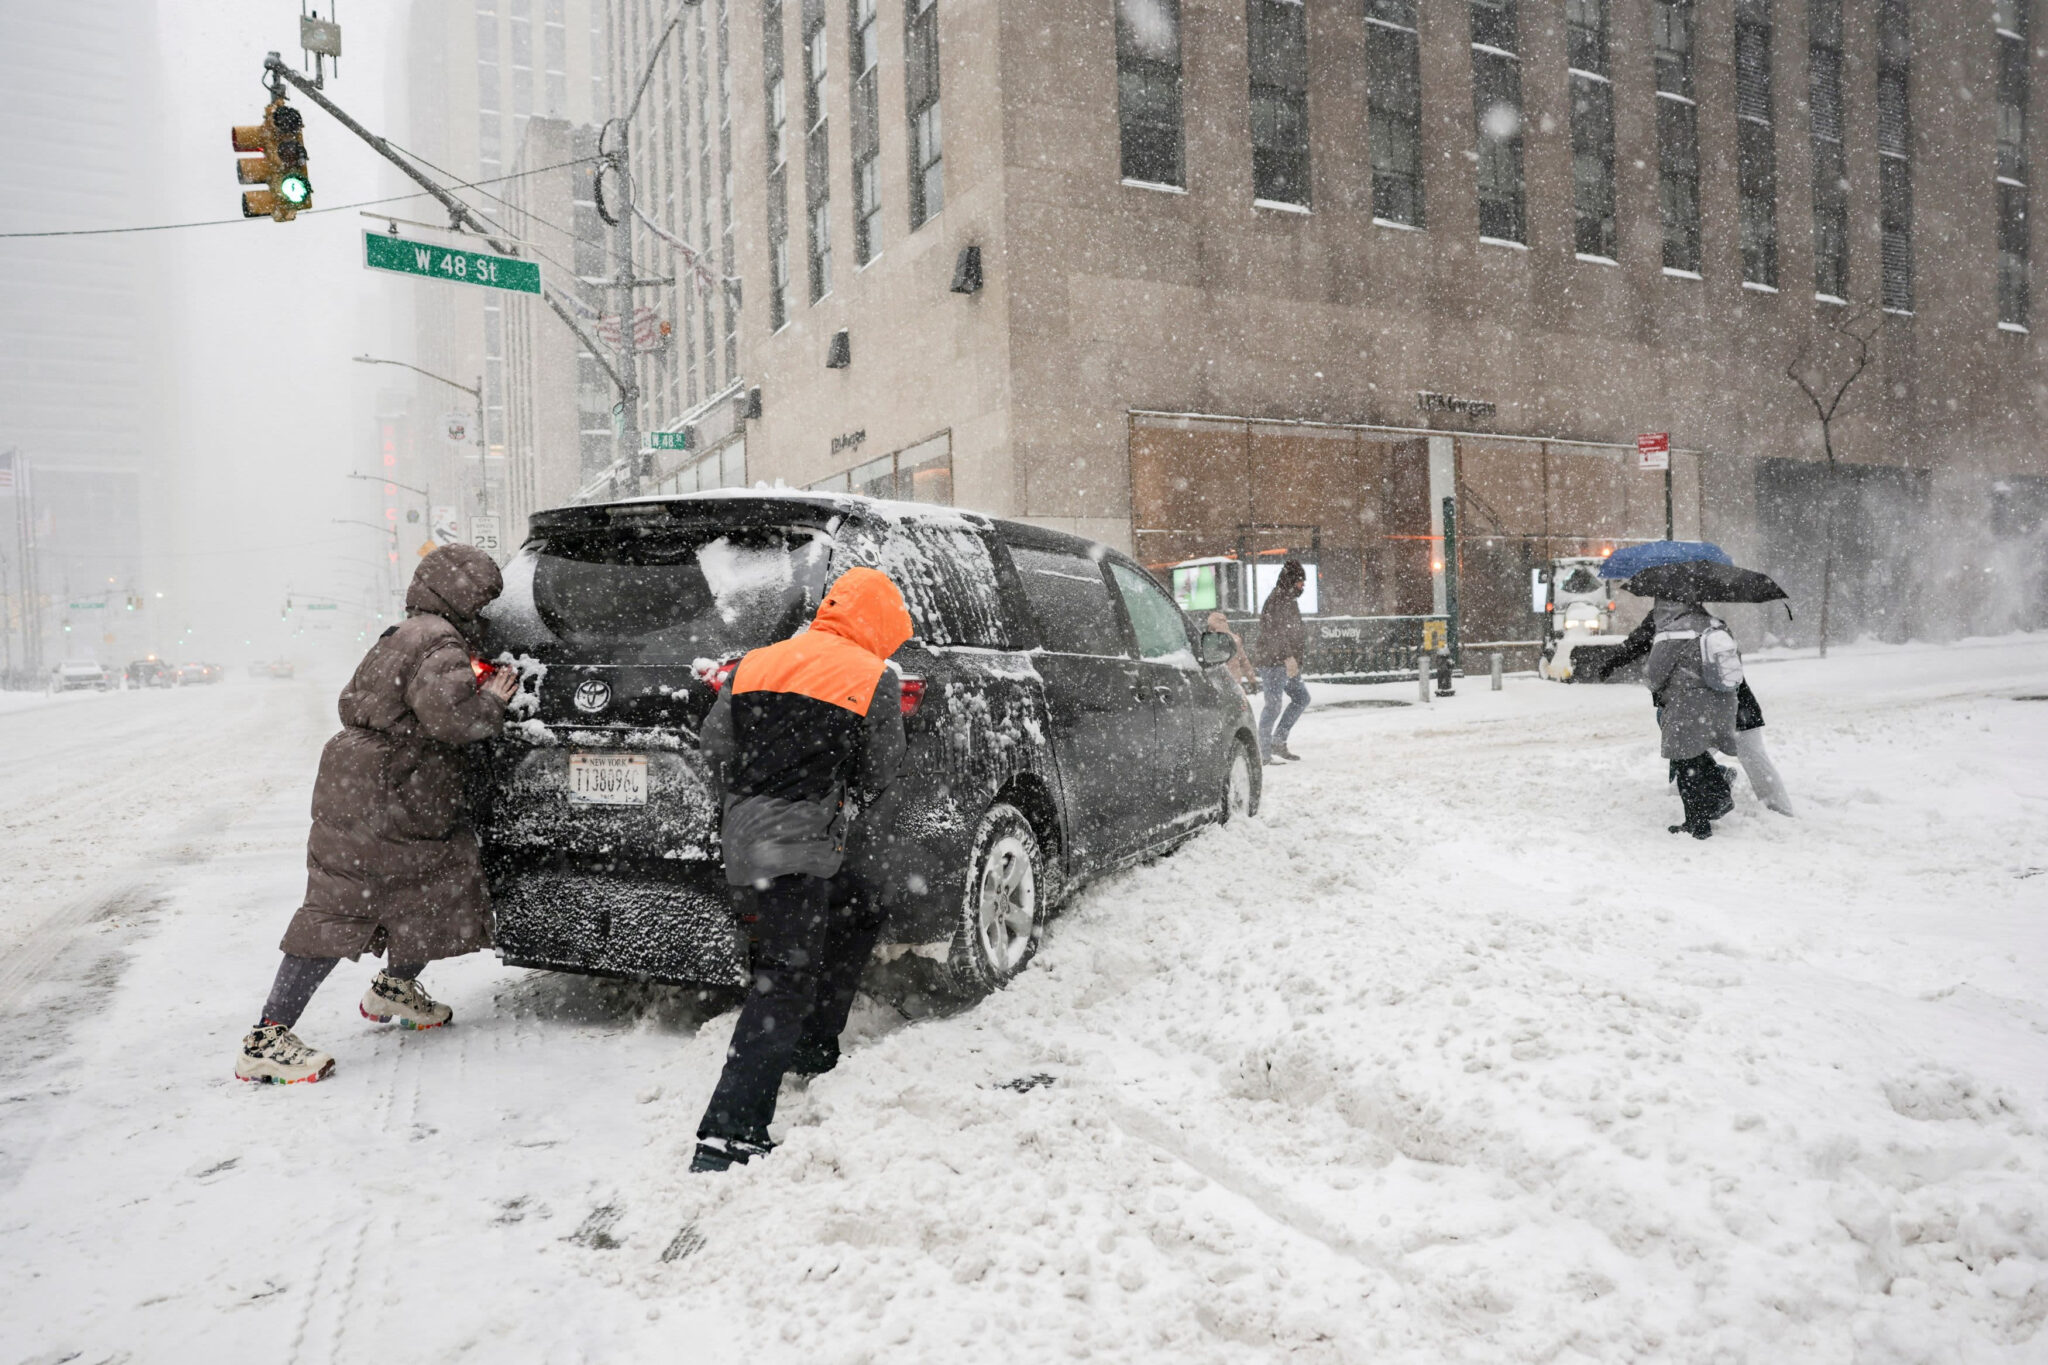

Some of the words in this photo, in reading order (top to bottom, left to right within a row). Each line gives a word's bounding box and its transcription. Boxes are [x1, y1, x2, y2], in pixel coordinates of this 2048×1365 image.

[415, 248, 431, 271] W
[440, 253, 467, 277] 48
[476, 258, 497, 282] St
[662, 433, 674, 448] 48
[475, 535, 498, 549] 25
[1320, 625, 1361, 643] Subway
[589, 758, 605, 767] NEW
[607, 758, 628, 767] YORK
